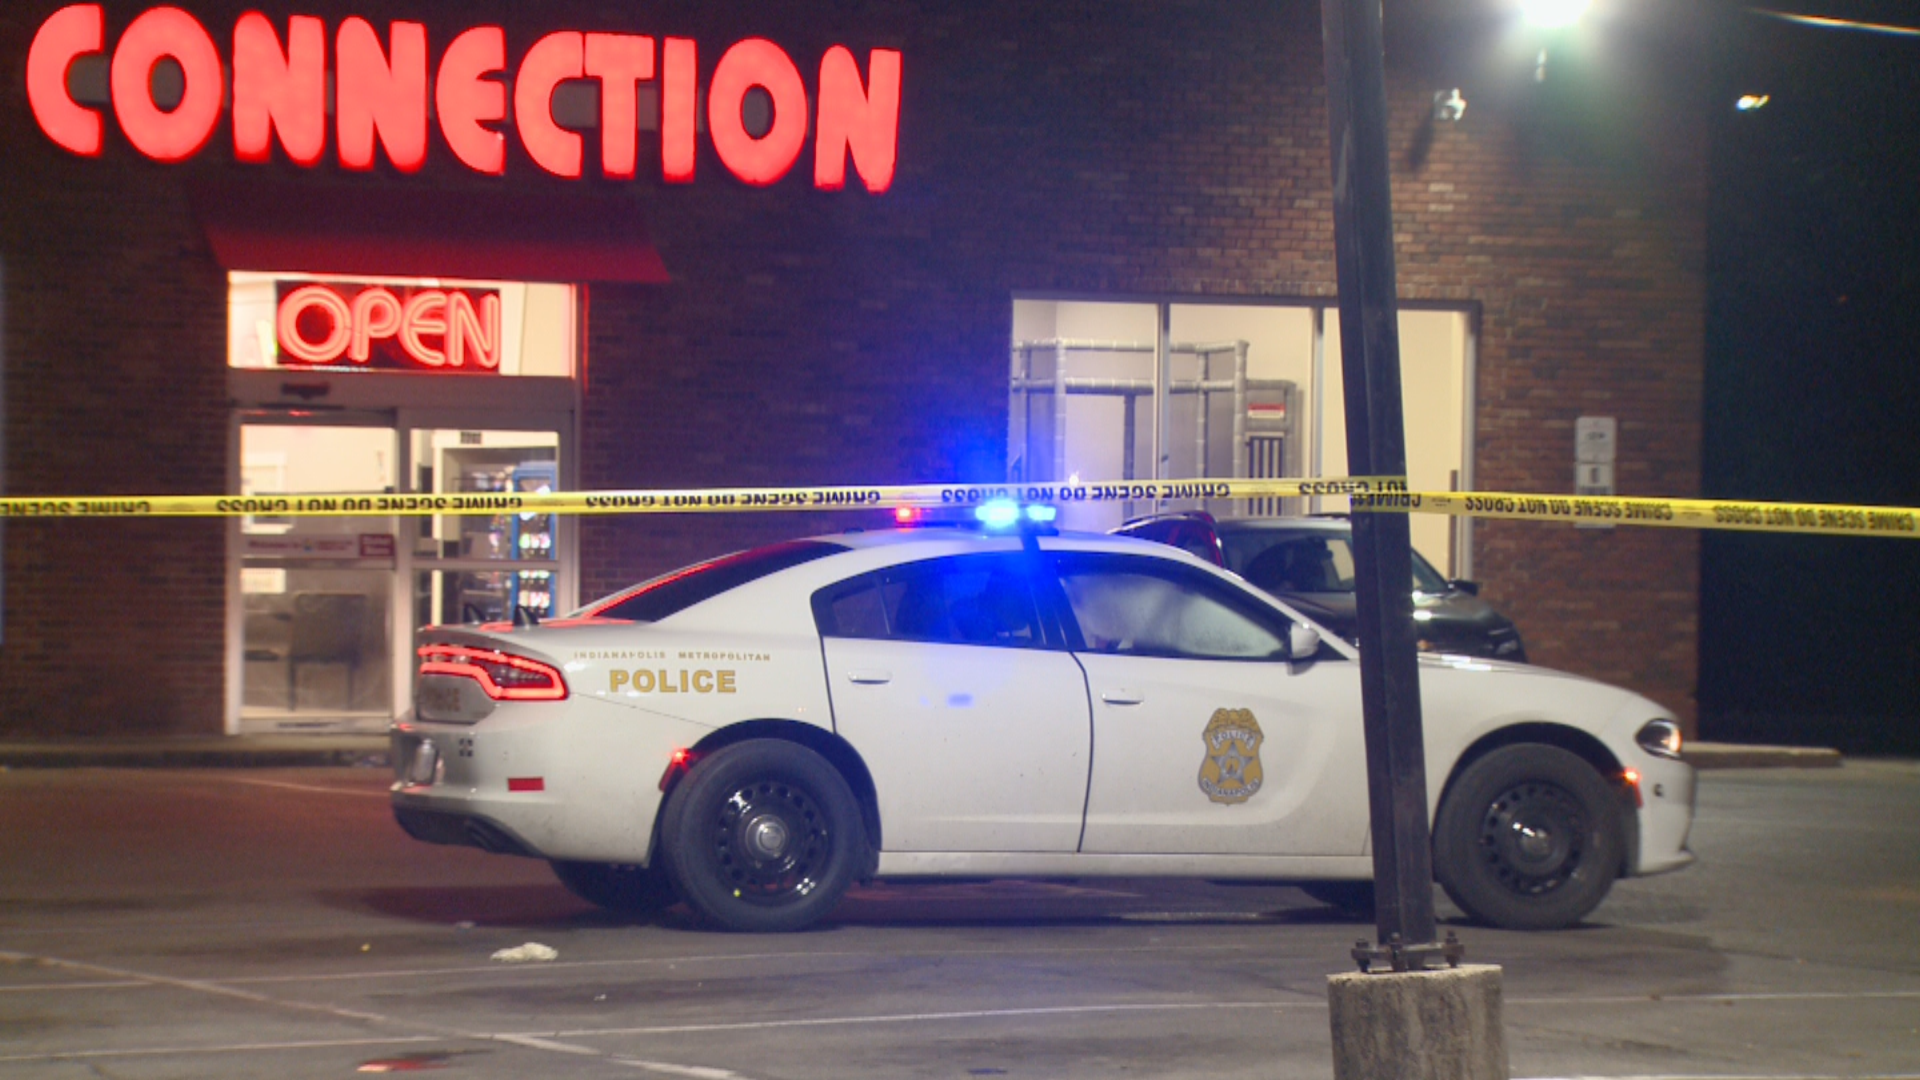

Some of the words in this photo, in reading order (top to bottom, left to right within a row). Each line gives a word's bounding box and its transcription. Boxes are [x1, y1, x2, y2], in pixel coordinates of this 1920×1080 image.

[26, 3, 902, 194] CONNECTION
[278, 284, 501, 368] OPEN
[740, 492, 807, 505] SCENE
[812, 490, 881, 504] CRIME
[1016, 487, 1054, 501] NOT
[1059, 486, 1087, 501] DO
[1091, 485, 1157, 499] SCENE
[1161, 483, 1231, 499] CRIME
[216, 499, 288, 512] CROSS
[343, 498, 372, 511] DO
[377, 497, 447, 511] SCENE
[452, 496, 523, 509] CRIME
[585, 495, 655, 507] CROSS
[663, 495, 701, 507] NOT
[707, 494, 735, 506] DO
[1465, 496, 1515, 513] CROSS
[1517, 498, 1547, 514] NOT
[1550, 499, 1571, 515] DO
[1574, 499, 1622, 517] SCENE
[1623, 501, 1673, 520] CRIME
[1713, 504, 1763, 524] CROSS
[1764, 506, 1794, 526] NOT
[1795, 507, 1817, 527] DO
[1818, 508, 1866, 529] SCENE
[1867, 510, 1915, 531] CRIME
[574, 651, 666, 660] INDIANAPOLIS
[678, 651, 771, 661] METROPOLITAN
[609, 668, 737, 693] POLICE
